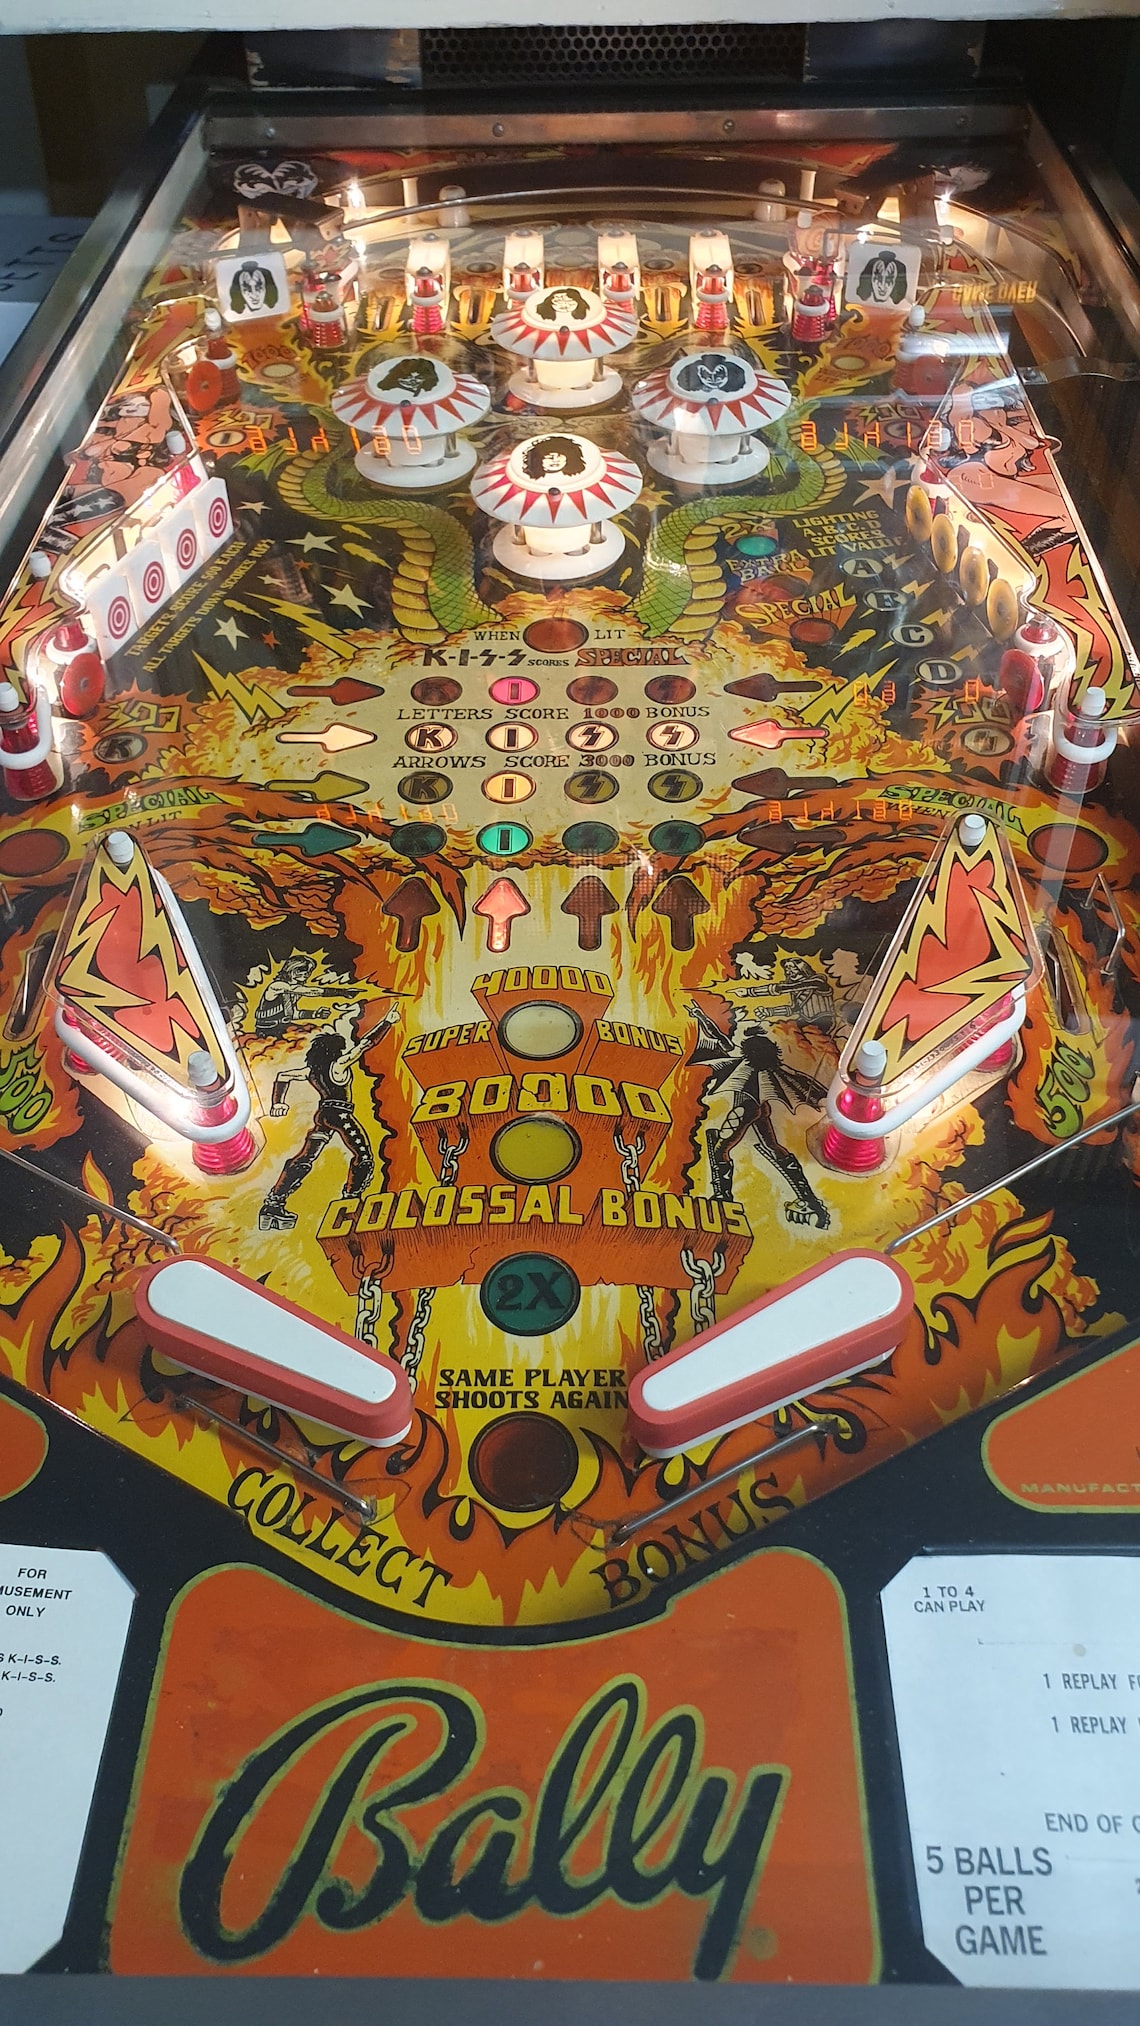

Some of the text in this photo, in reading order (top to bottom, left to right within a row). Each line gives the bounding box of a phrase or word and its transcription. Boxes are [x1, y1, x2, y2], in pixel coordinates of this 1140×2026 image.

[722, 518, 773, 539] 2X
[792, 510, 879, 529] LIGHTING
[807, 537, 907, 558] LIT VALUE
[810, 529, 886, 547] SCORES
[725, 549, 809, 571] EXTRA
[739, 561, 813, 584] BALL
[124, 541, 247, 657] TARGETS SCORE 500 EACH
[735, 582, 856, 629] SPECIAL
[142, 656, 167, 673] ALL
[160, 616, 202, 654] TARGETS
[195, 590, 228, 616] DOWN
[220, 559, 256, 589] SCORES
[475, 630, 626, 641] WHEN LIT
[528, 658, 570, 667] SCORES
[575, 648, 691, 667] SPECIAL
[397, 706, 710, 720] LETTERS SCORE 1000 BONUS
[392, 752, 716, 769] ARROWS SCORE 3000 BONUS
[77, 785, 230, 834] SPECIAL
[148, 811, 182, 826] LIT
[878, 785, 1028, 837] SPECIAL
[471, 966, 616, 992] 40000
[402, 1020, 684, 1056] SUPER BONUS
[411, 1073, 672, 1123] 80000
[1035, 1042, 1096, 1139] 500
[316, 1185, 755, 1239] COLOSSAL BONUS
[496, 1271, 568, 1312] 2X
[439, 1368, 626, 1388] SAME PLAYER
[435, 1389, 629, 1409] SHOOTS AGAIN
[227, 1466, 796, 1608] COLLECT BONUS
[17, 1567, 47, 1579] FOR
[923, 1585, 975, 1598] 1 TO 4
[6, 1605, 45, 1617] ONLY
[914, 1600, 985, 1613] CAN PLAY
[8, 1653, 61, 1665] K-I-S-S.
[1, 1671, 56, 1682] K-I-S-S.
[1043, 1673, 1050, 1689] 1
[1062, 1673, 1117, 1690] REPLAY
[1051, 1716, 1059, 1733] 1
[1070, 1716, 1126, 1734] REPLAY
[180, 1680, 785, 1983] Bally
[1045, 1812, 1088, 1832] END
[1097, 1814, 1122, 1833] OF
[926, 1845, 1053, 1876] 5 BALLS
[965, 1885, 1025, 1916] PER
[955, 1924, 1047, 1956] GAME
